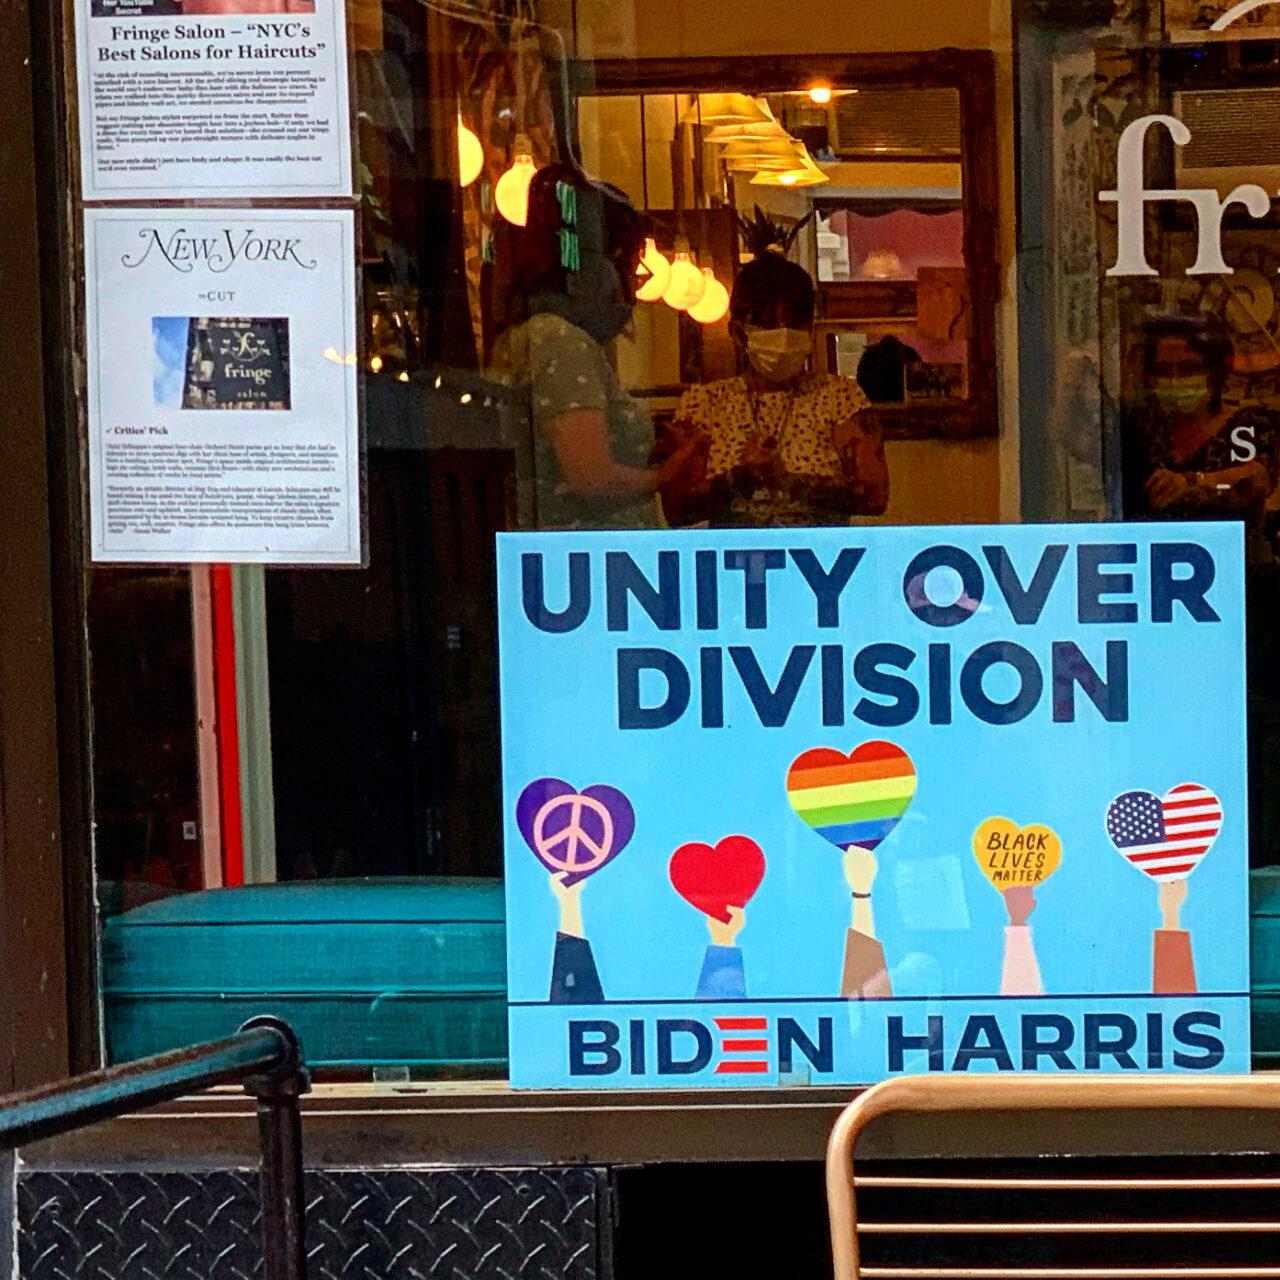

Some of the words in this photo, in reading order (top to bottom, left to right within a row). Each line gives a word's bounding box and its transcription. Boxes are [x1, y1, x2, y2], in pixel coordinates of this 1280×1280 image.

[111, 25, 170, 43] Fringe
[174, 23, 225, 40] Salon
[98, 45, 136, 62] Best
[140, 44, 201, 60] Salons
[206, 42, 233, 60] for
[207, 291, 236, 301] CUT
[224, 363, 272, 385] fringe
[148, 426, 169, 435] Pick
[520, 547, 866, 634] UNITY
[903, 542, 1222, 627] OVER
[616, 640, 1129, 731] DIVISION
[987, 832, 1050, 851] BLACK
[988, 851, 1046, 869] LIVES
[992, 869, 1044, 882] MATTER
[568, 1015, 834, 1077] BIDEN
[886, 1010, 1225, 1074] HARRIS
